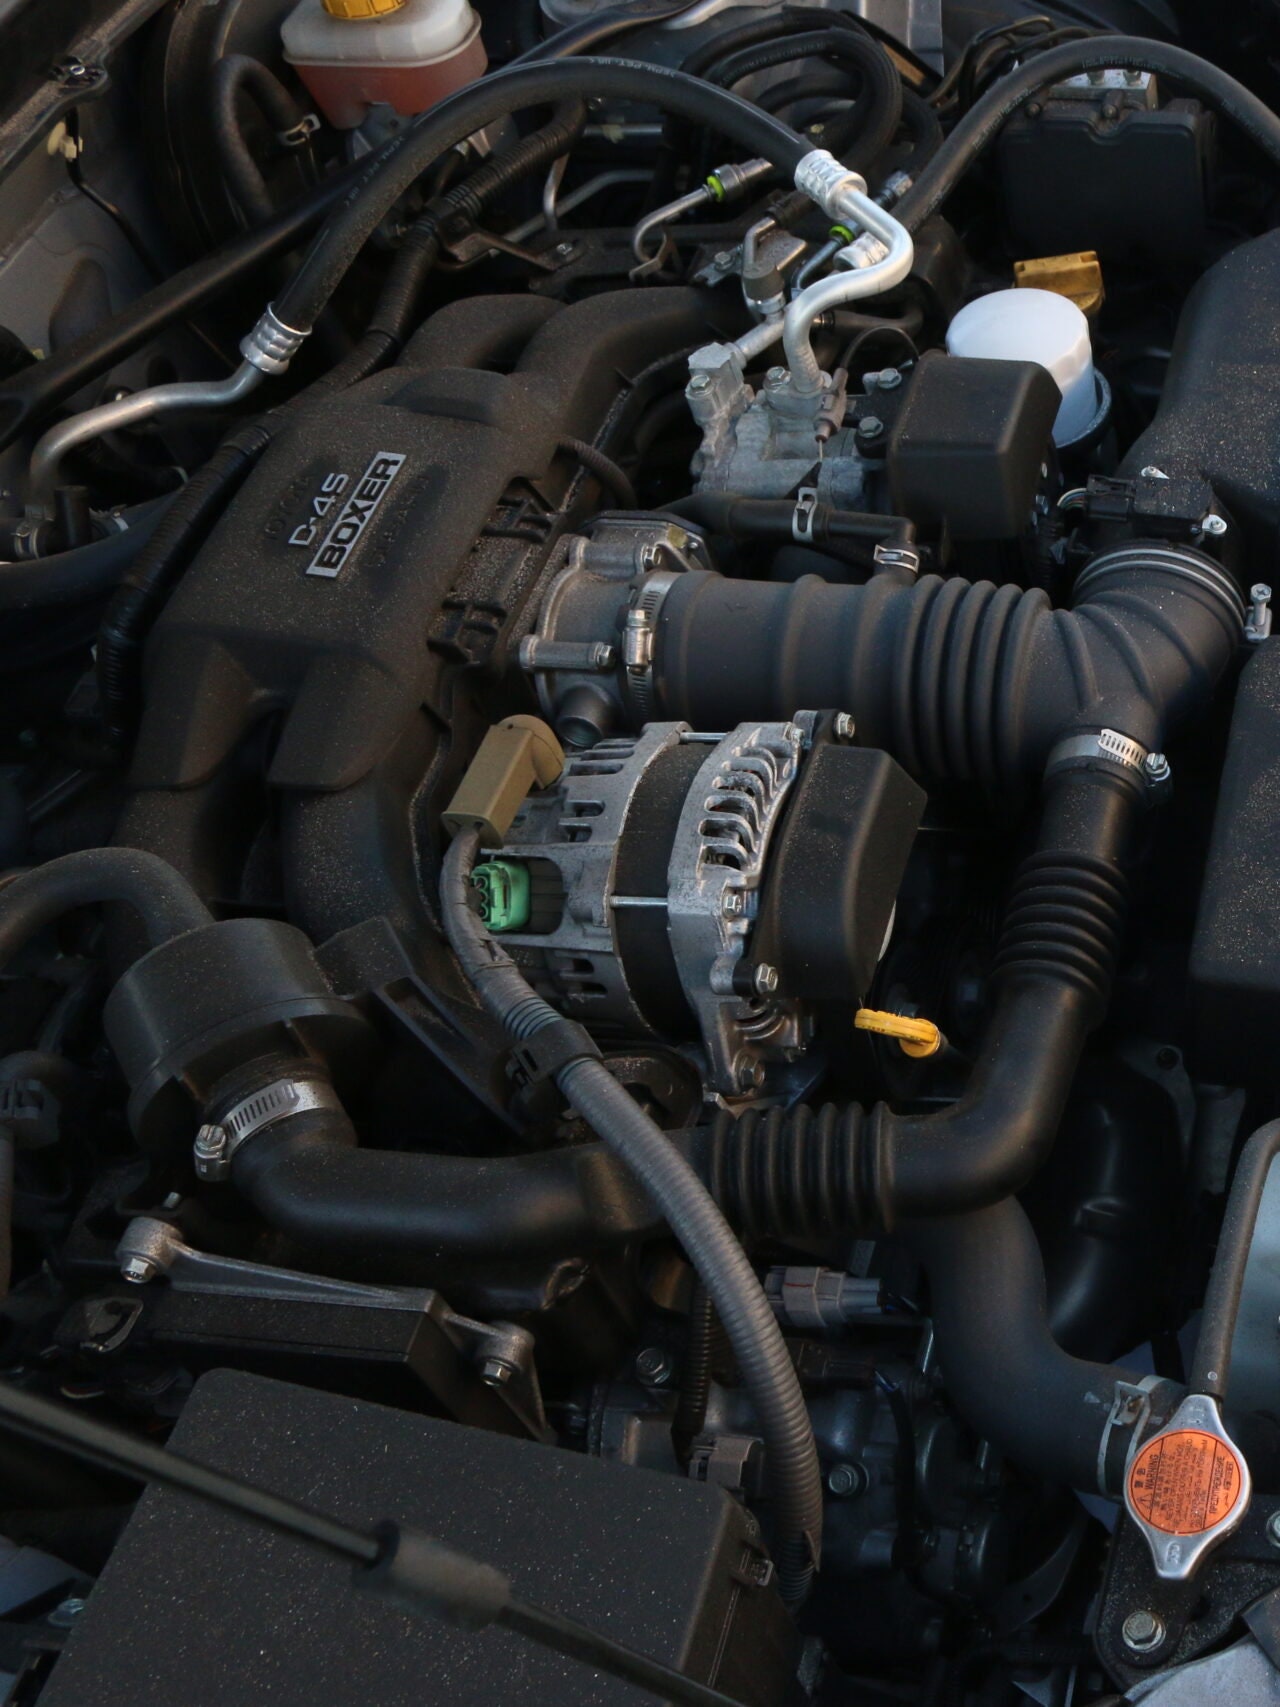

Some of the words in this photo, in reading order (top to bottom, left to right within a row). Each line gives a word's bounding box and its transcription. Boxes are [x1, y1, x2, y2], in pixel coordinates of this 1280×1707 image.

[288, 472, 349, 546] D-4S
[313, 457, 400, 570] BOXER
[1146, 1453, 1158, 1490] WARNING
